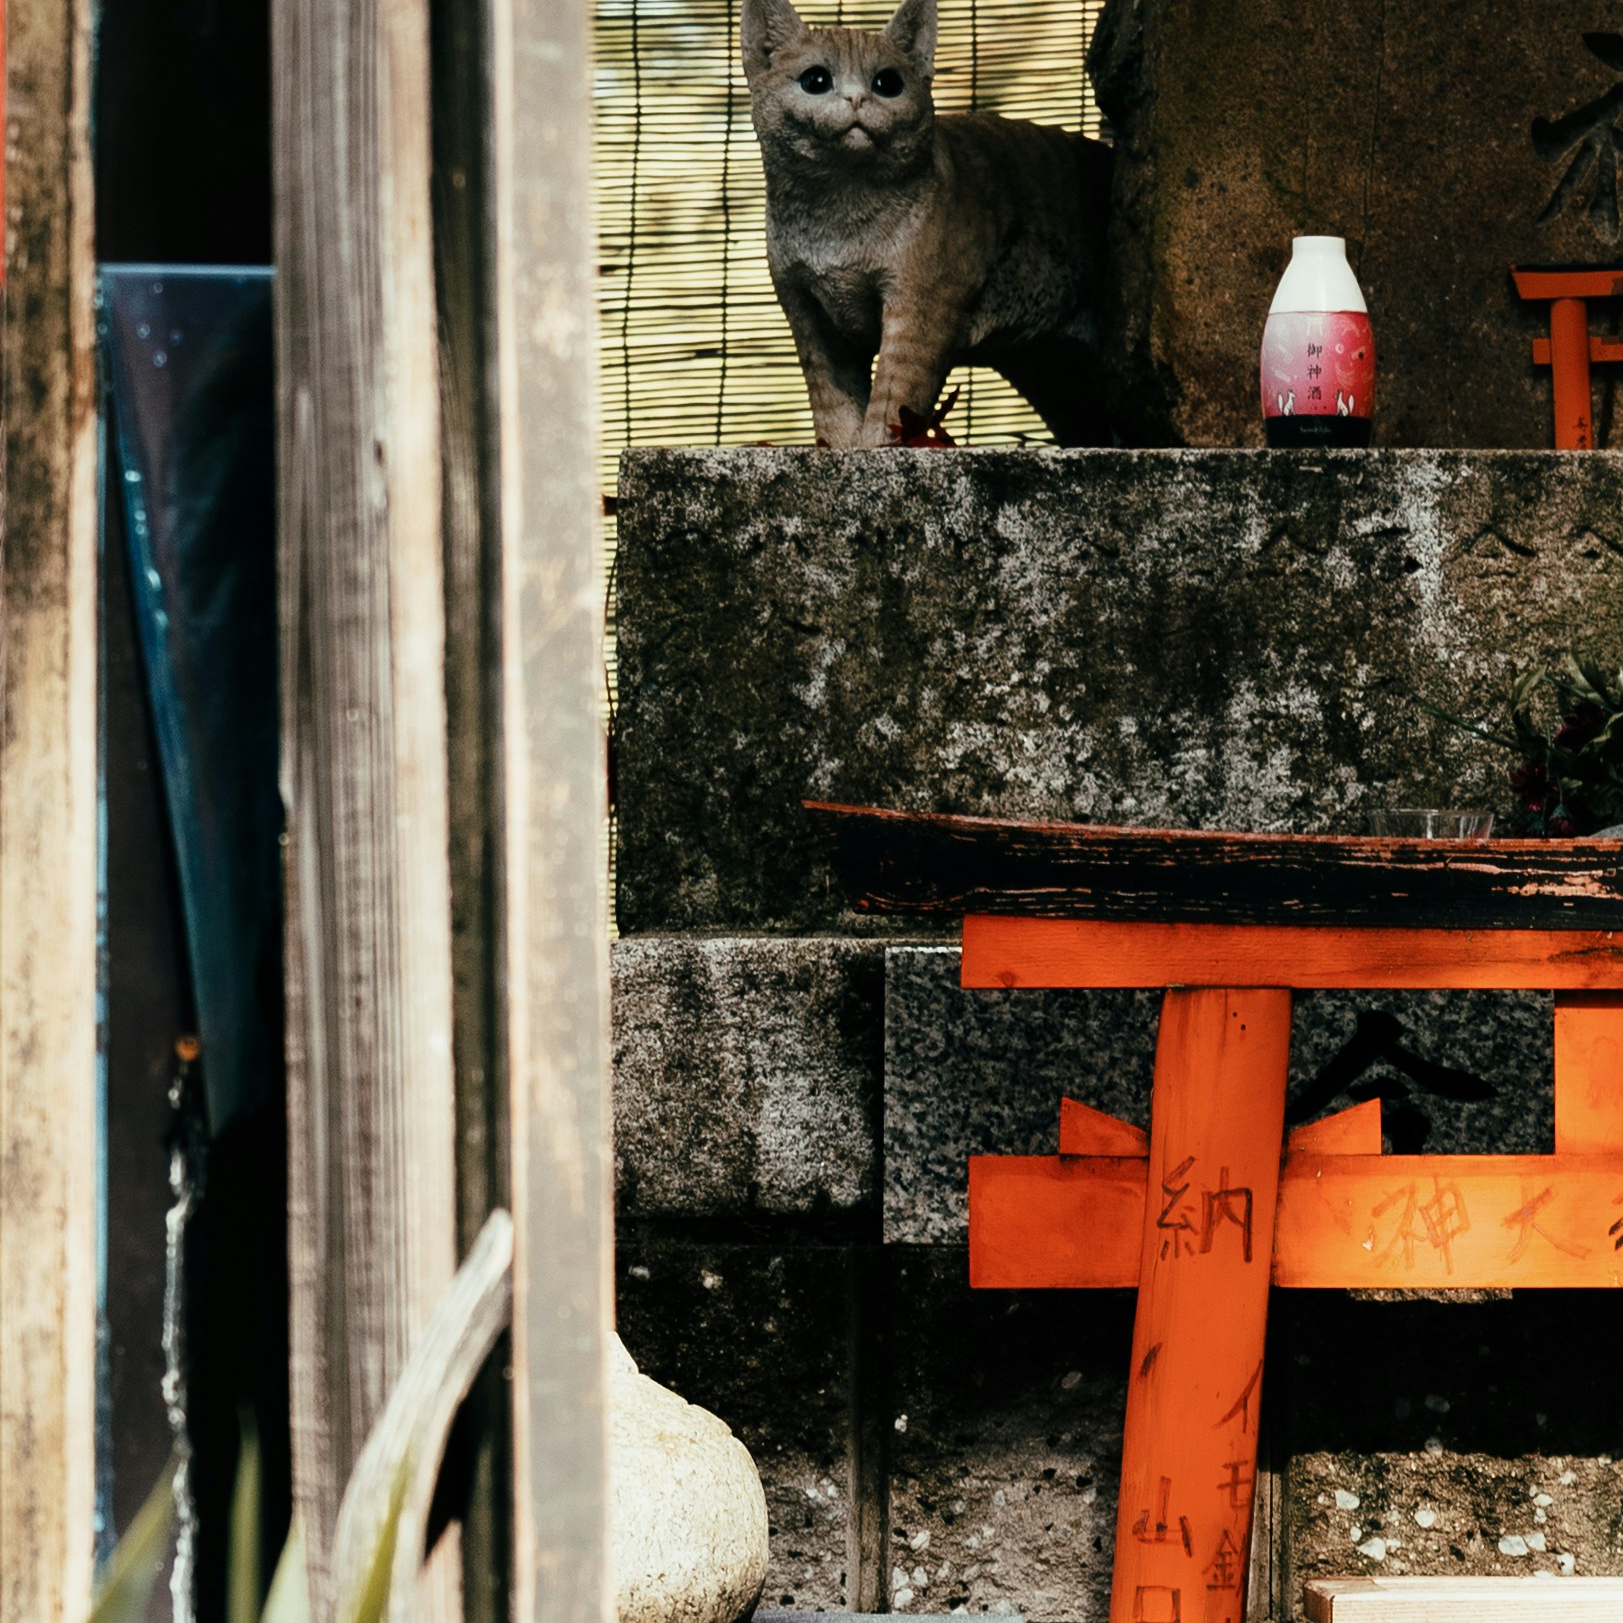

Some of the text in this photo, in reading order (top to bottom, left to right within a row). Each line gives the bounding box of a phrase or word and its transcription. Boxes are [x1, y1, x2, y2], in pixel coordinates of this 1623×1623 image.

[1306, 342, 1324, 401] 御神酒
[1156, 1156, 1255, 1264] 納
